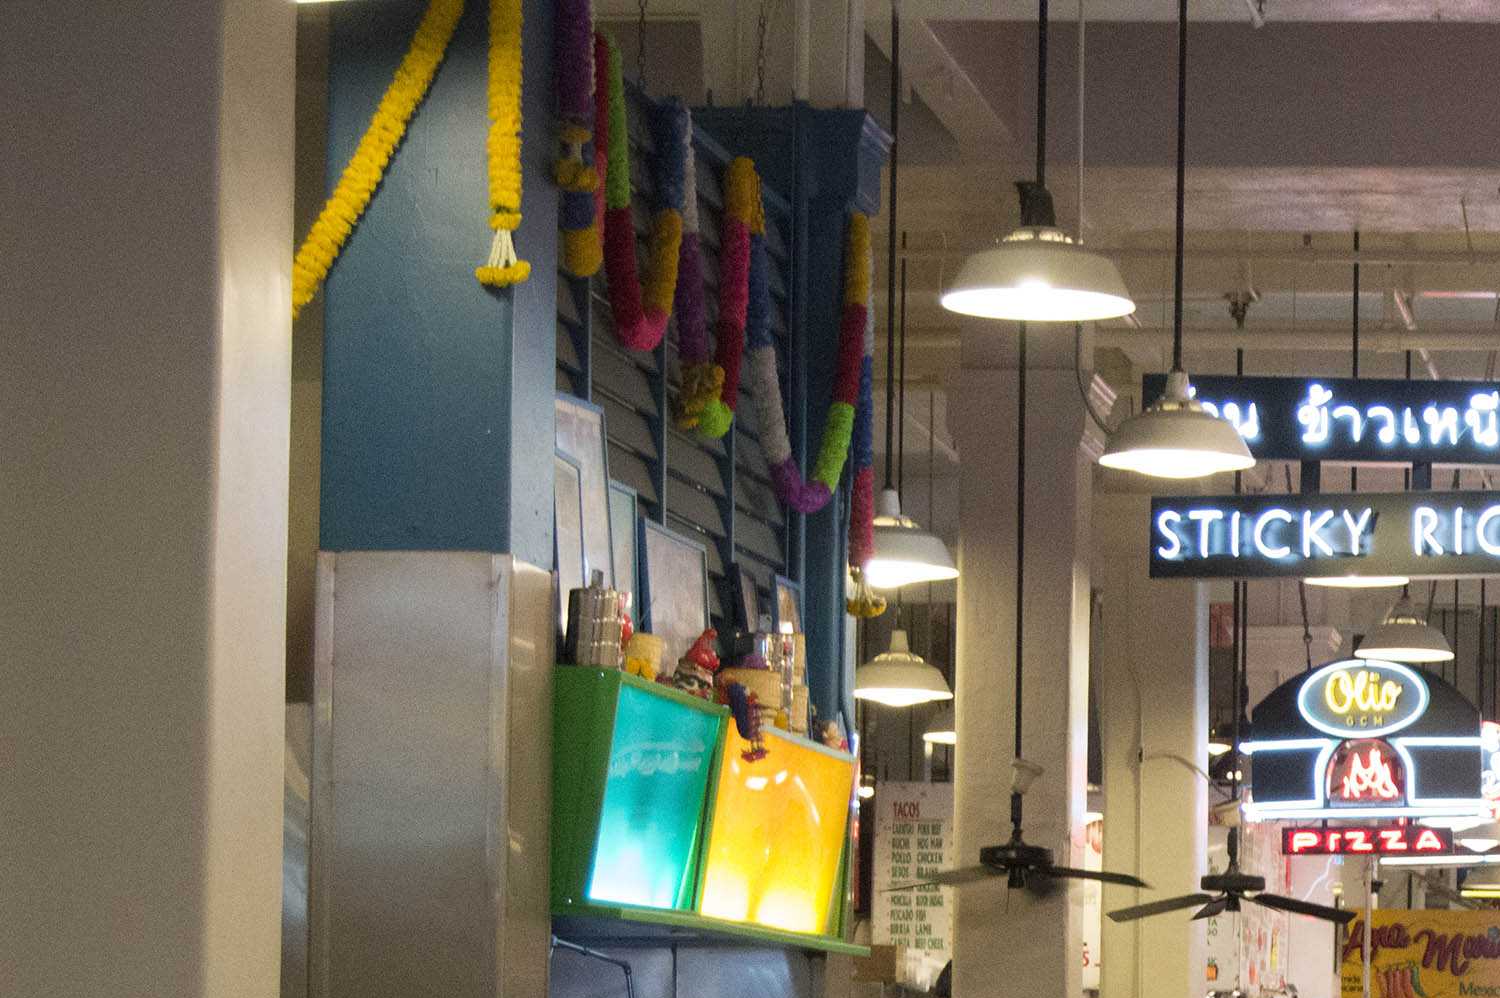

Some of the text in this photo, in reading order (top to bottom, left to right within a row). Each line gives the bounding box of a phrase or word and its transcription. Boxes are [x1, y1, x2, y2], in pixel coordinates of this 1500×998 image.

[1157, 507, 1374, 560] STICKY
[1325, 669, 1403, 715] Olio
[892, 801, 921, 819] TACOS
[1292, 830, 1442, 852] PIZZA
[1342, 919, 1412, 963] Ana
